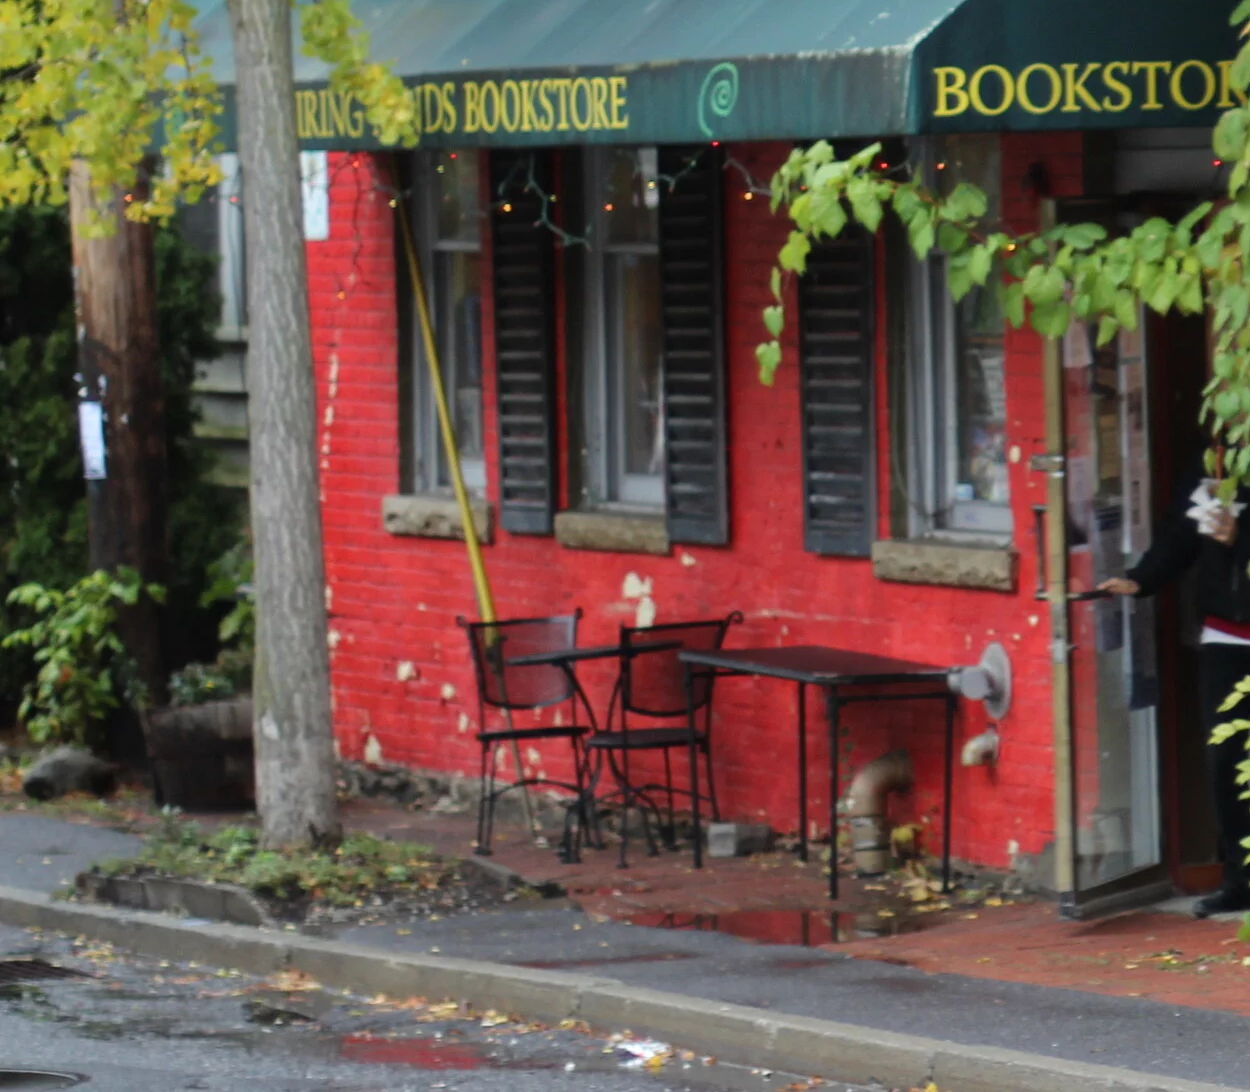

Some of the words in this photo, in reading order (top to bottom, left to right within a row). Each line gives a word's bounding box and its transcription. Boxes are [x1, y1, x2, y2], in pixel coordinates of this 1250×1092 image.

[294, 87, 364, 139] IRING
[463, 76, 629, 133] BOOKSTORE
[932, 59, 1250, 117] BOOKSTOR
